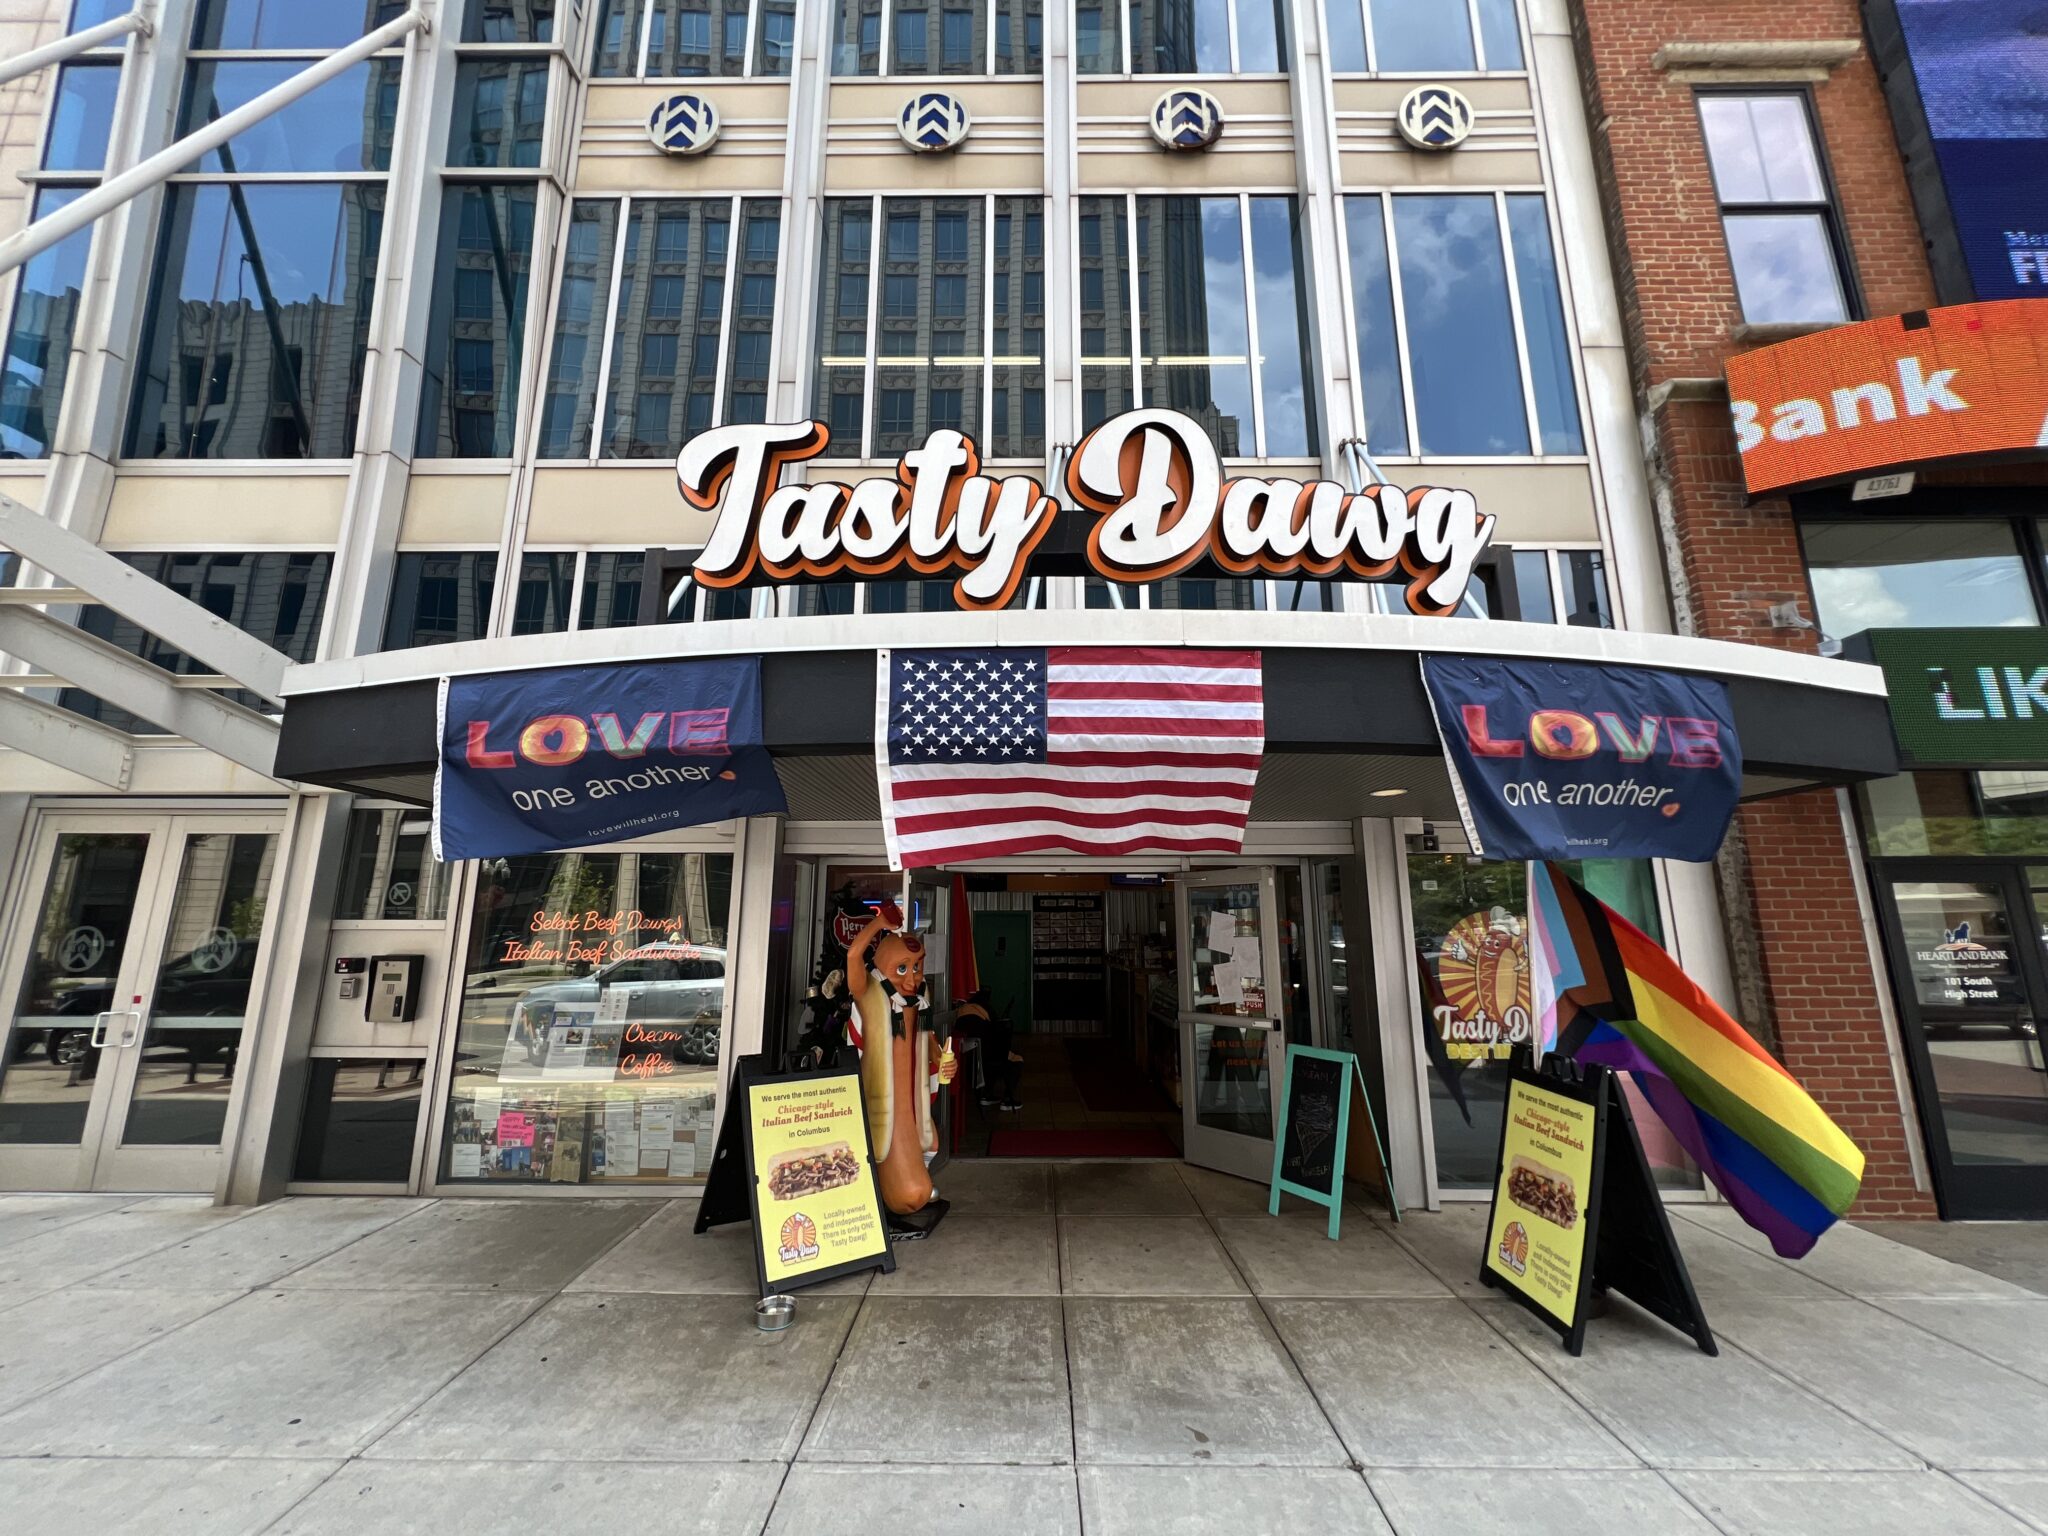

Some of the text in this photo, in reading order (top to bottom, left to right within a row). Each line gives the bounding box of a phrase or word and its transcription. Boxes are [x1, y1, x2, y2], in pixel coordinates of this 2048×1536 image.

[677, 407, 1495, 616] Tasty Dawg
[466, 708, 732, 768] LOVE
[1461, 705, 1722, 768] LOVE
[512, 764, 712, 811] one another
[1503, 778, 1674, 806] one another
[587, 810, 680, 837] lovewillheal.org
[530, 911, 580, 932] Select
[583, 911, 623, 935] Beef
[500, 941, 563, 962] Italian
[567, 941, 609, 965] Beef
[1917, 950, 2008, 961] HEARTLAND BANK
[1945, 976, 1993, 986] 101 South
[1945, 989, 1999, 1000] High Street
[626, 1023, 682, 1042] Cream
[1433, 1005, 1500, 1048] Tasty
[621, 1053, 674, 1079] Coffee
[762, 1095, 772, 1103] We
[819, 1086, 847, 1096] authentic
[778, 1099, 834, 1114] Chicago-style
[762, 1106, 853, 1128] Italian Beef Sandwich
[796, 1126, 831, 1137] Columbus
